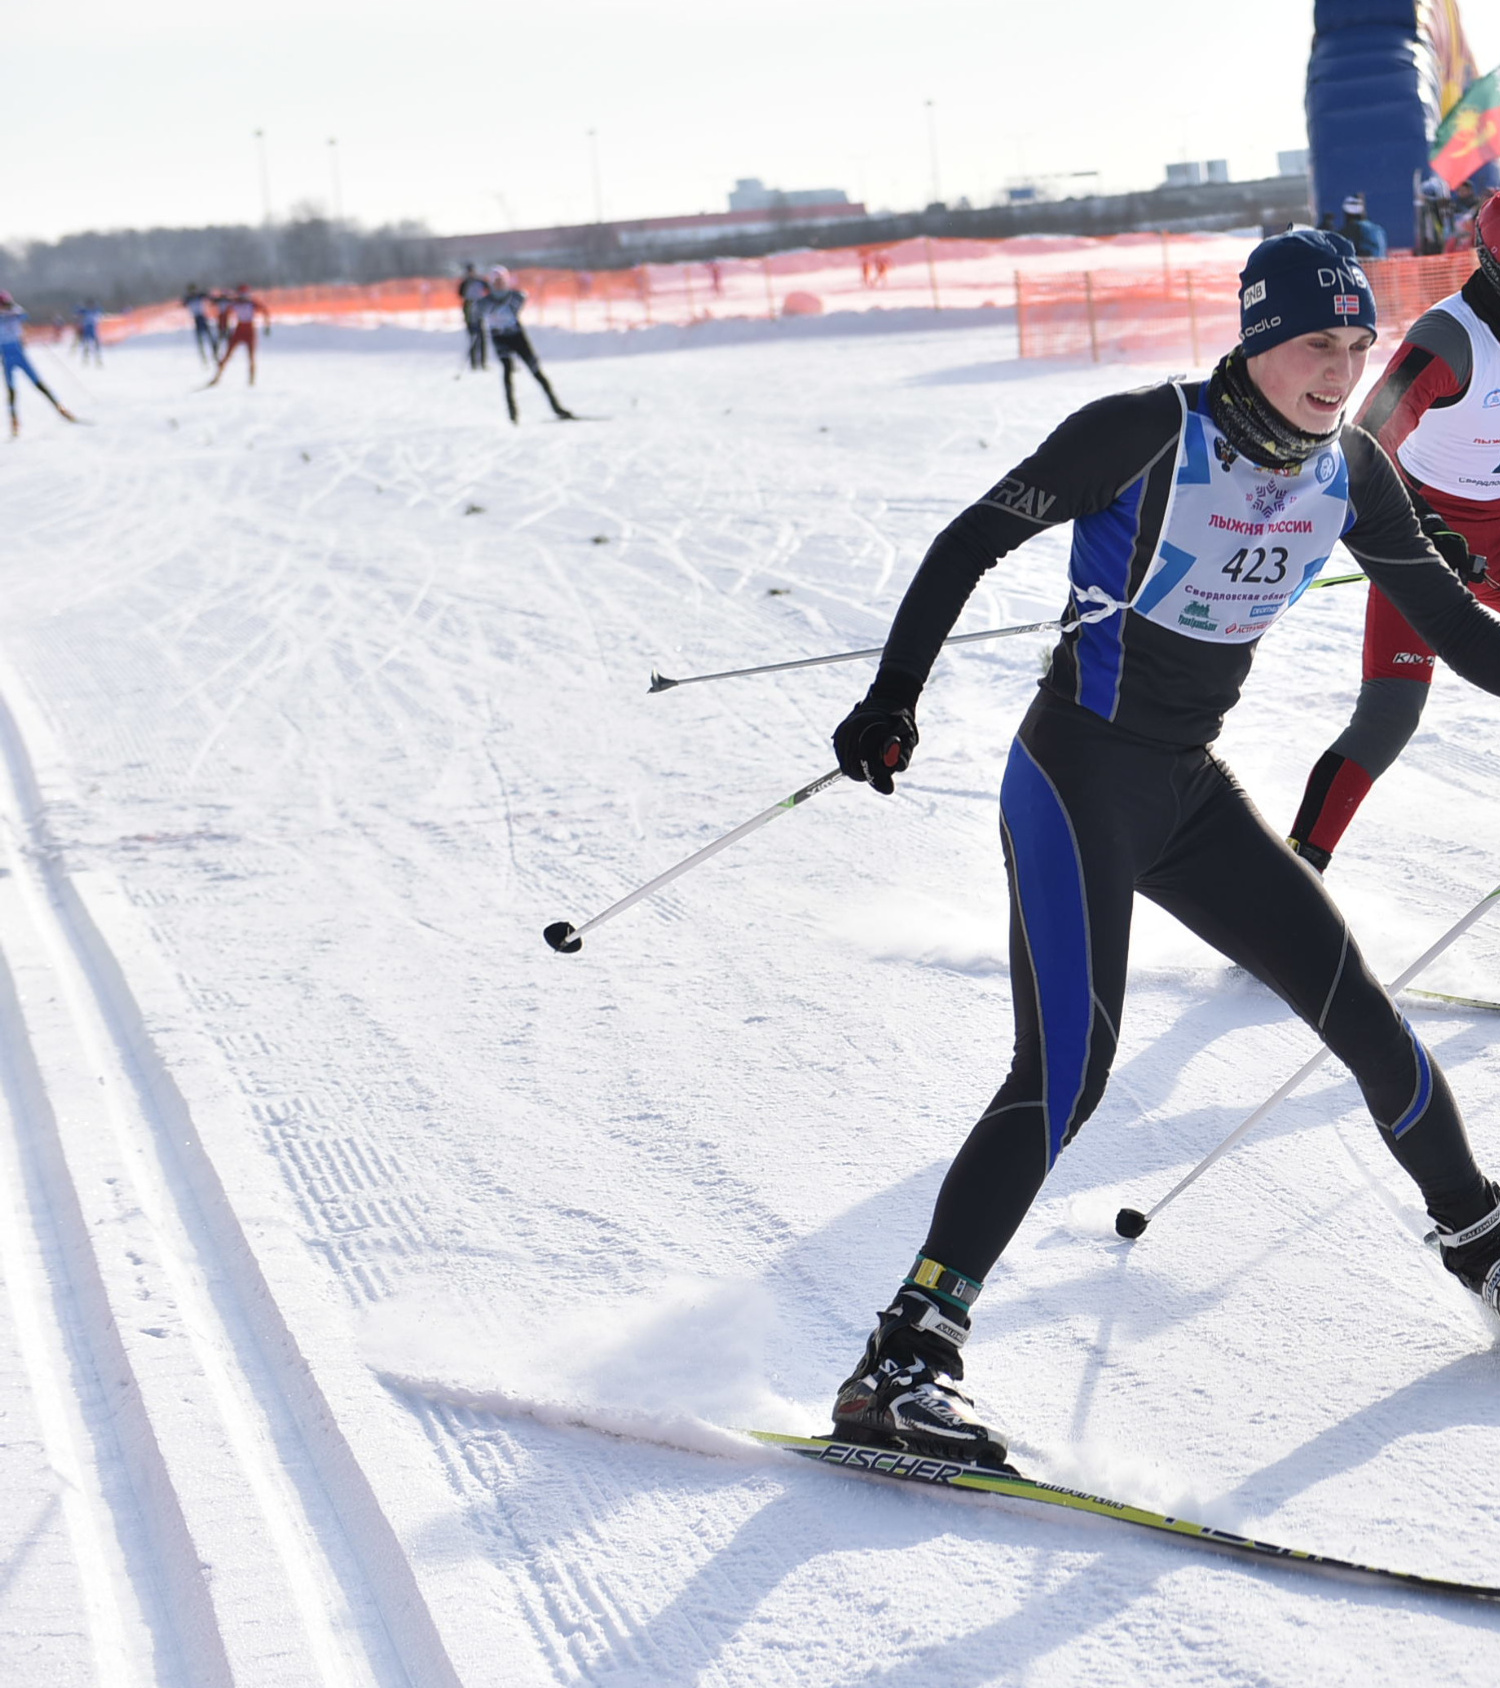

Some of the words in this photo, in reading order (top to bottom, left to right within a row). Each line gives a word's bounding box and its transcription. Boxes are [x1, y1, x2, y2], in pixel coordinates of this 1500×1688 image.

[1317, 267, 1368, 291] DNB
[1244, 284, 1264, 307] DNB
[1244, 315, 1282, 338] odlo
[1208, 513, 1264, 536] ЛЫЖНЯ
[1221, 546, 1289, 584] 423
[1184, 584, 1261, 601] Свердловская
[819, 1444, 964, 1483] FISCHER
